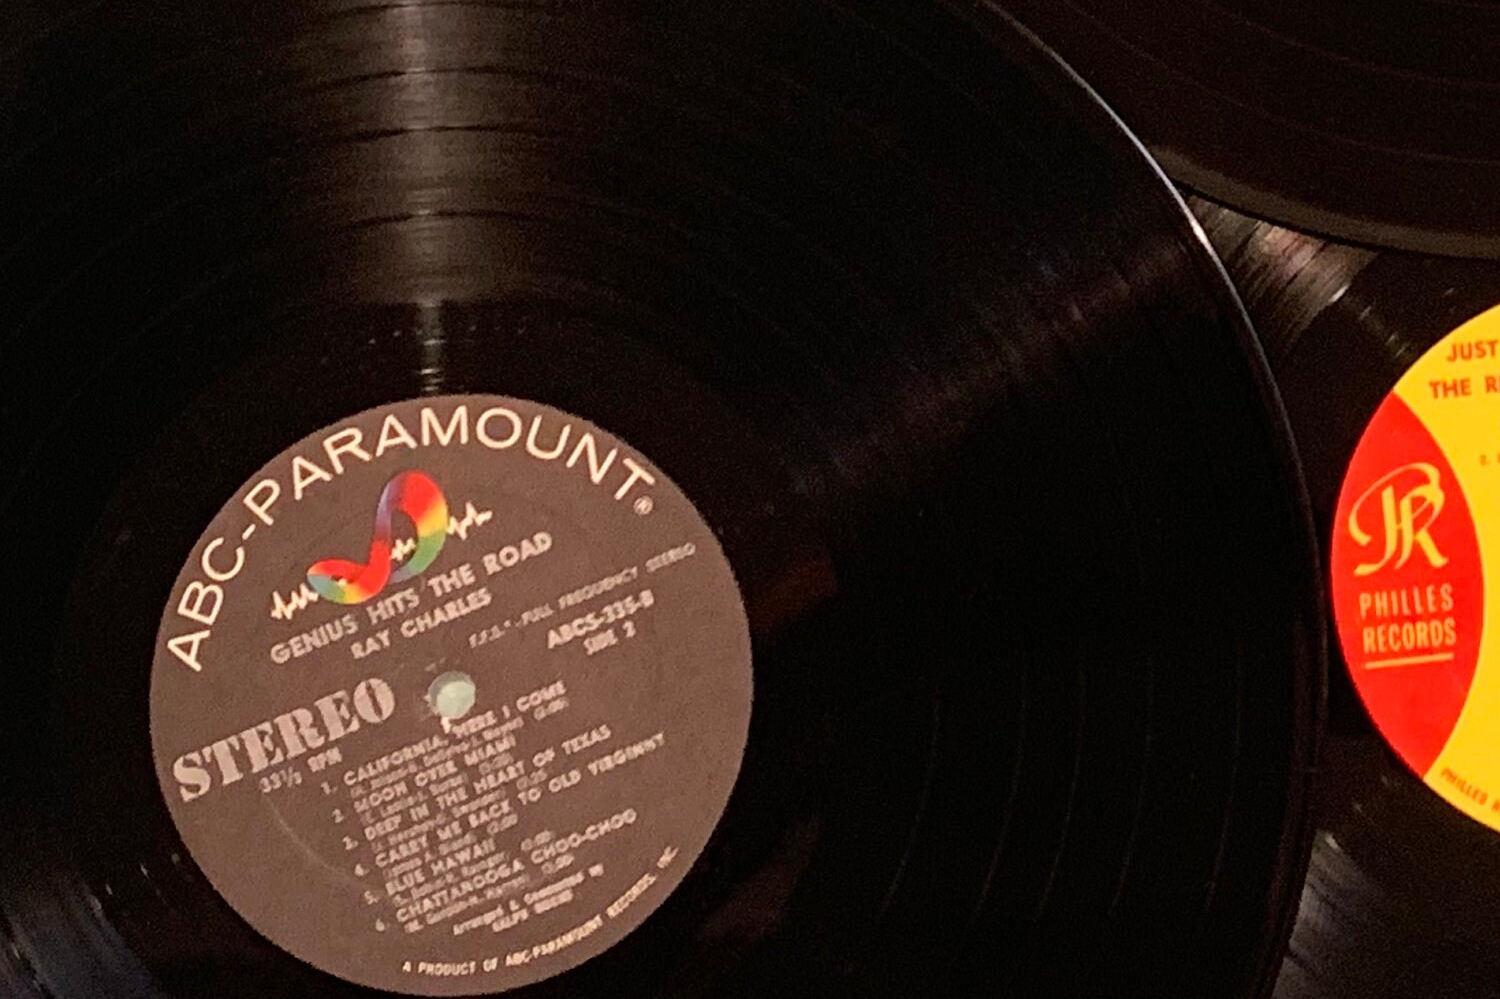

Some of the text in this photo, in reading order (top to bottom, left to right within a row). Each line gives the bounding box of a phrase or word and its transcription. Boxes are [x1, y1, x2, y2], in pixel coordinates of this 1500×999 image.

[1446, 338, 1499, 363] JUST
[1428, 378, 1473, 400] THE
[168, 405, 655, 673] ABC-PARAMOUNT
[270, 531, 553, 664] GENIUS HITS THE ROAD
[1358, 582, 1456, 621] PHILLES
[351, 630, 392, 659] RAY
[400, 587, 493, 638] CHARLES
[1362, 616, 1458, 655] RECORDS
[515, 679, 568, 713] COME
[173, 677, 396, 803] STEREO
[354, 780, 408, 813] MOON
[414, 760, 458, 788] OVER
[463, 731, 517, 767] MIAMI
[410, 802, 431, 822] IN
[436, 785, 469, 810] THE
[473, 760, 525, 795] HEART
[532, 746, 556, 769] OF
[561, 723, 612, 756] TEXAS
[1439, 766, 1488, 807] PHILLES
[468, 798, 512, 829] BACK
[517, 786, 543, 806] TO
[548, 768, 583, 794] OLD
[529, 807, 638, 866] CHOO-CHOO
[385, 870, 425, 897] BLUE
[402, 960, 412, 974] A
[417, 959, 476, 978] PRODUCT
[483, 955, 500, 972] OF
